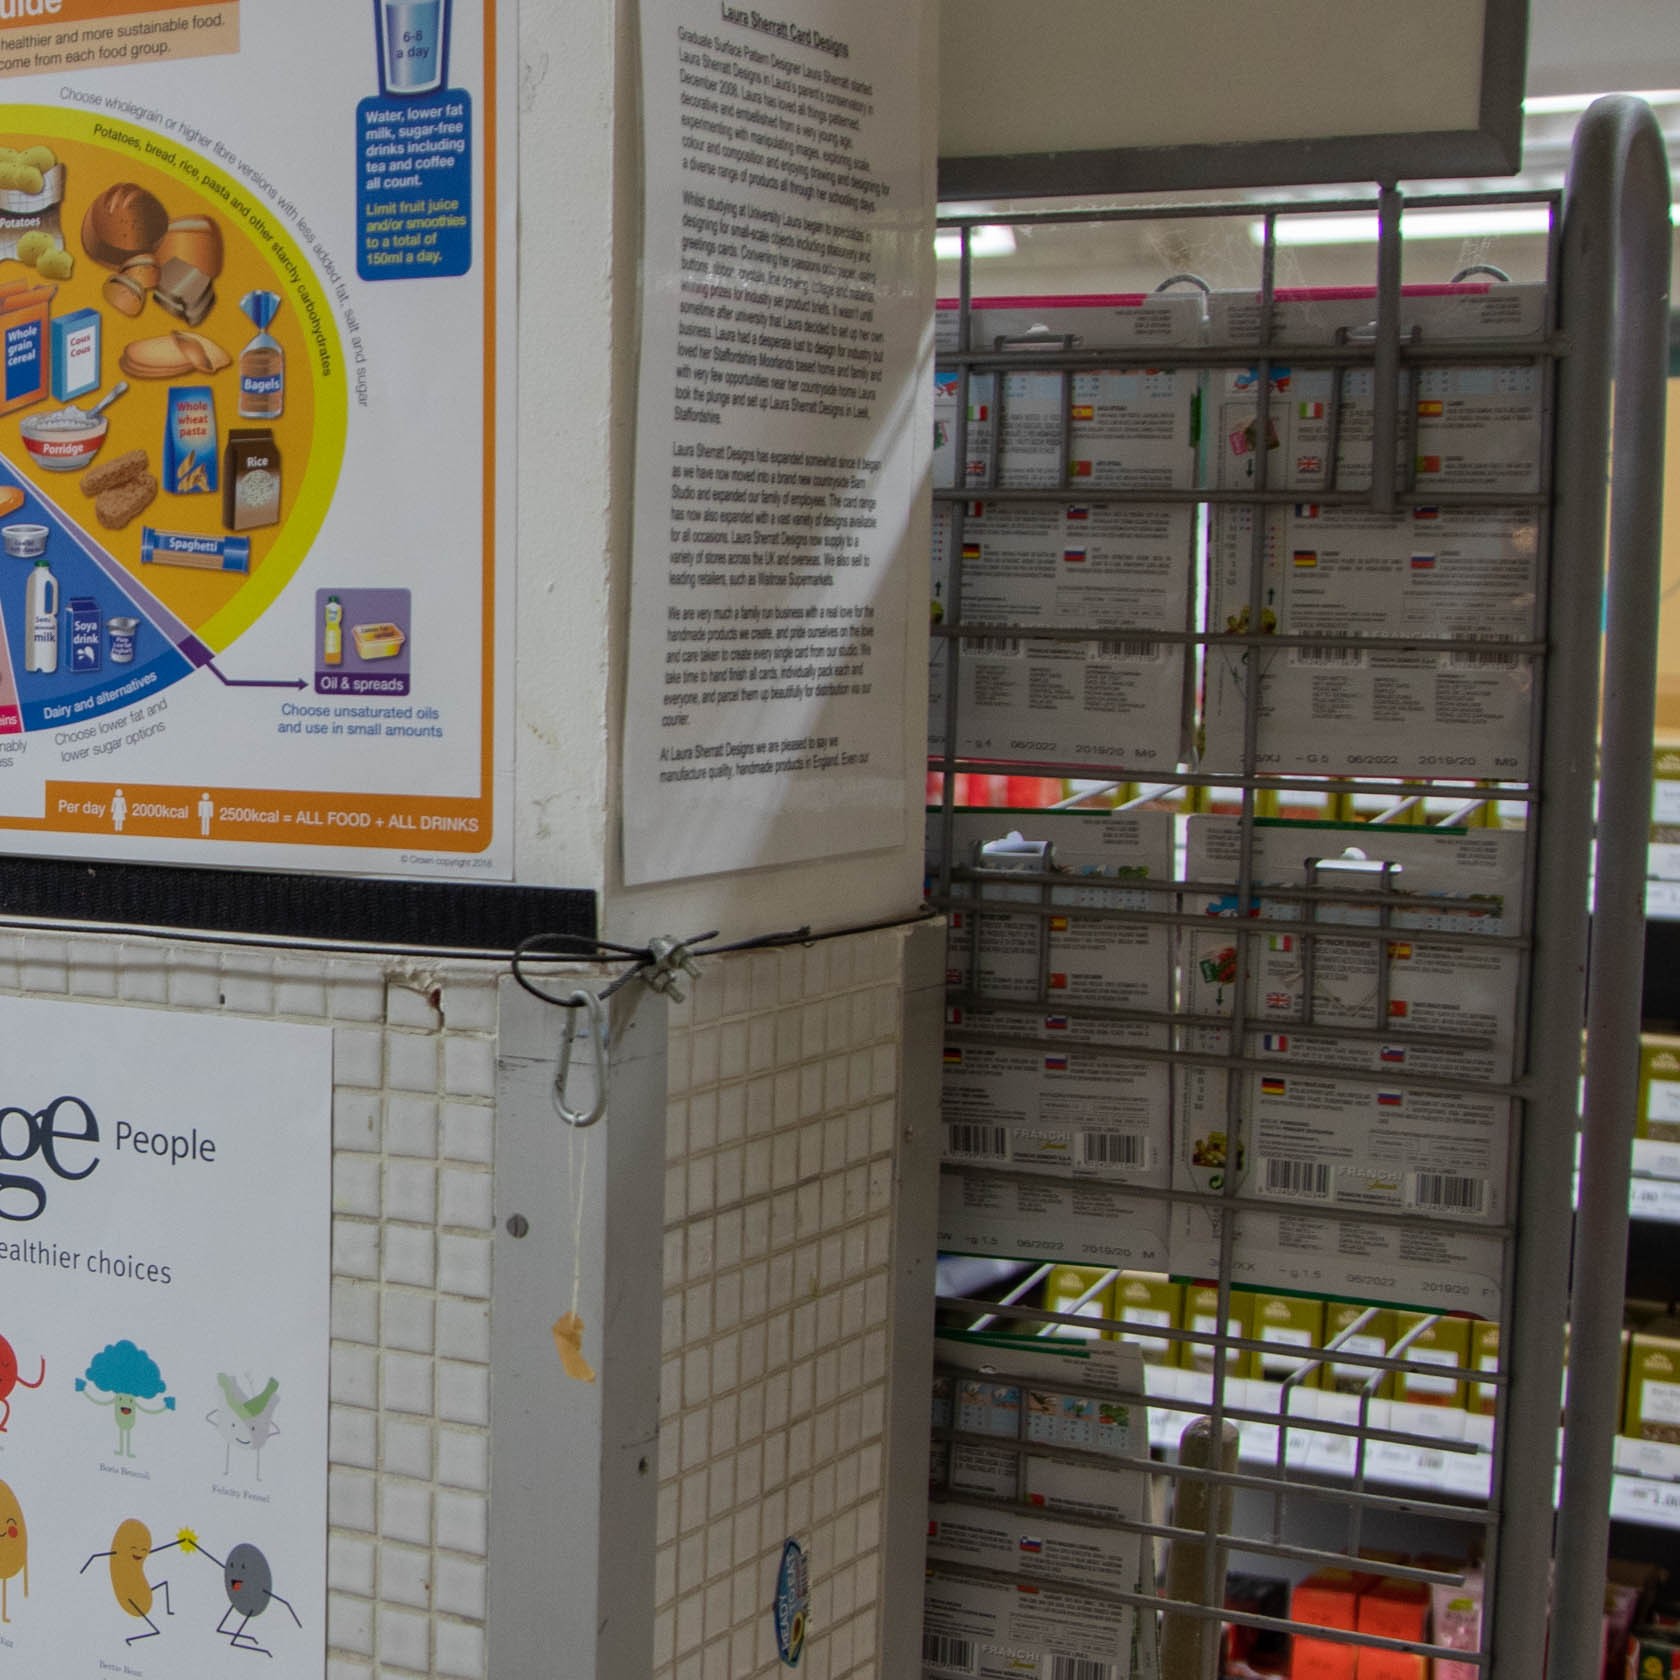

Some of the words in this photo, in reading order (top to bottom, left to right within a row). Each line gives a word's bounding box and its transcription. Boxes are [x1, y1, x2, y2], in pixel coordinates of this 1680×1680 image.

[0, 31, 52, 50] healthier
[55, 29, 79, 45] and
[82, 28, 114, 42] more
[117, 17, 189, 39] sustainable
[192, 13, 226, 30] food.
[721, 0, 749, 25] Laura
[789, 23, 812, 45] Card
[813, 31, 849, 58] Designs
[396, 48, 403, 58] a
[407, 45, 430, 60] day
[366, 110, 405, 124] Water,
[407, 107, 444, 121] lower
[446, 104, 464, 117] fat
[366, 126, 396, 141] milk,
[398, 121, 464, 140] sugar-free
[366, 142, 405, 157] drinks
[407, 138, 465, 155] including
[366, 160, 386, 173] tea
[389, 157, 412, 171] and
[415, 155, 455, 169] coffee
[366, 177, 381, 190] all
[383, 175, 423, 189] count.
[0, 216, 41, 229] Potatoes
[244, 377, 280, 392] Bagels
[43, 442, 84, 457] Porridge
[247, 456, 269, 468] Rice
[169, 537, 219, 553] Spaghetti
[74, 620, 98, 633] Soya
[73, 632, 99, 645] drink
[321, 676, 339, 690] Oil
[341, 677, 350, 690] &
[353, 676, 404, 692] spreads
[43, 701, 73, 720] Dairy
[74, 695, 95, 711] and
[96, 670, 158, 706] alternatives
[281, 703, 331, 718] Choose
[333, 706, 413, 720] unsaturated
[416, 707, 440, 721] oils
[278, 721, 303, 734] and
[305, 724, 329, 735] use
[333, 722, 344, 735] in
[347, 722, 382, 736] small
[385, 724, 443, 738] amounts
[58, 800, 80, 814] Per
[82, 801, 106, 818] day
[131, 803, 189, 819] 2000kcal
[220, 807, 280, 824] 2500kcal
[295, 811, 324, 826] ALL
[327, 811, 372, 827] FOOD
[388, 814, 417, 829] ALL
[420, 816, 480, 832] DRINKS
[116, 1121, 217, 1165] People
[86, 1250, 173, 1285] choices
